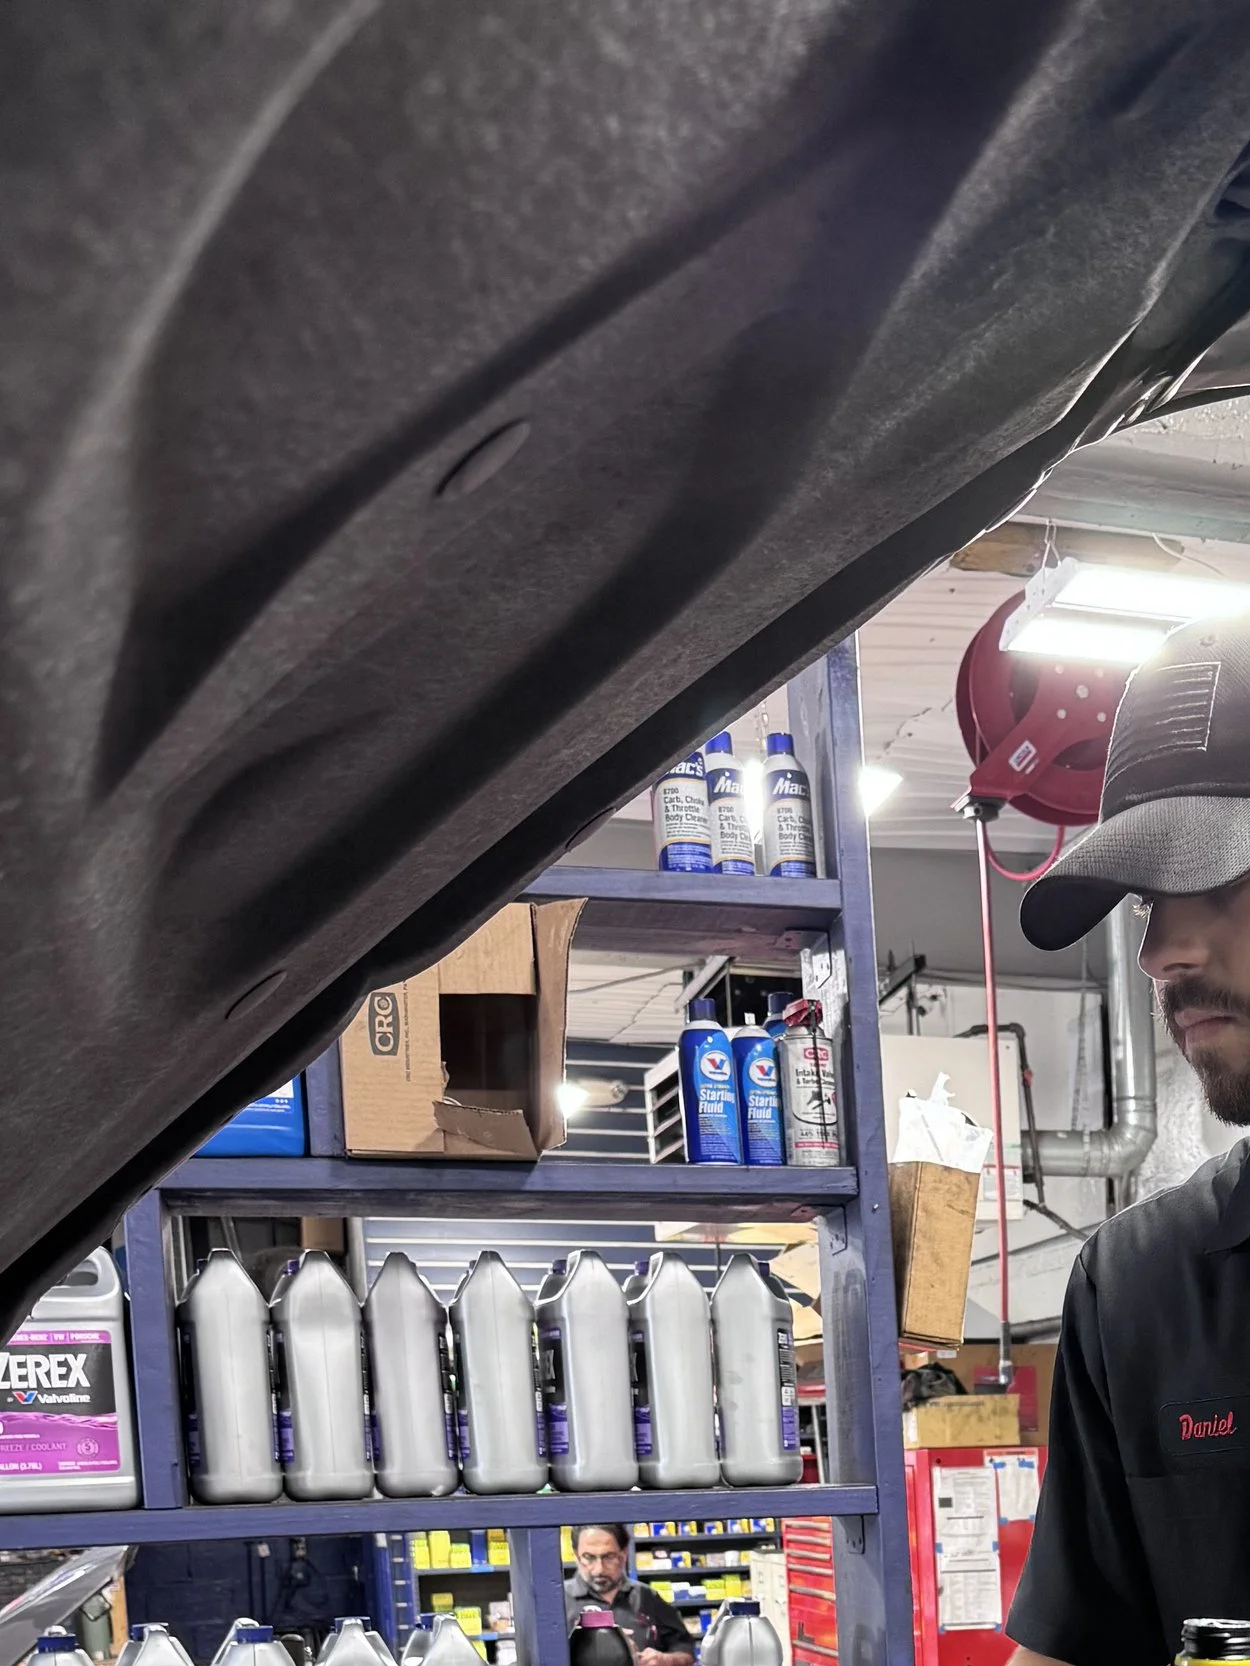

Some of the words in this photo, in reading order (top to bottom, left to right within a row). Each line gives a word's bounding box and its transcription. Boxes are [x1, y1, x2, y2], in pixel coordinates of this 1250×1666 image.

[663, 796, 683, 806] Carb,
[665, 814, 683, 823] Body
[374, 997, 394, 1051] CRC
[795, 1068, 819, 1077] Intak
[700, 1088, 735, 1103] Starting
[699, 1102, 723, 1114] Fluid
[748, 1107, 772, 1119] Fluid
[0, 1352, 91, 1389] ZEREX
[37, 1393, 91, 1404] Valvoline
[1179, 1410, 1238, 1440] Daniel
